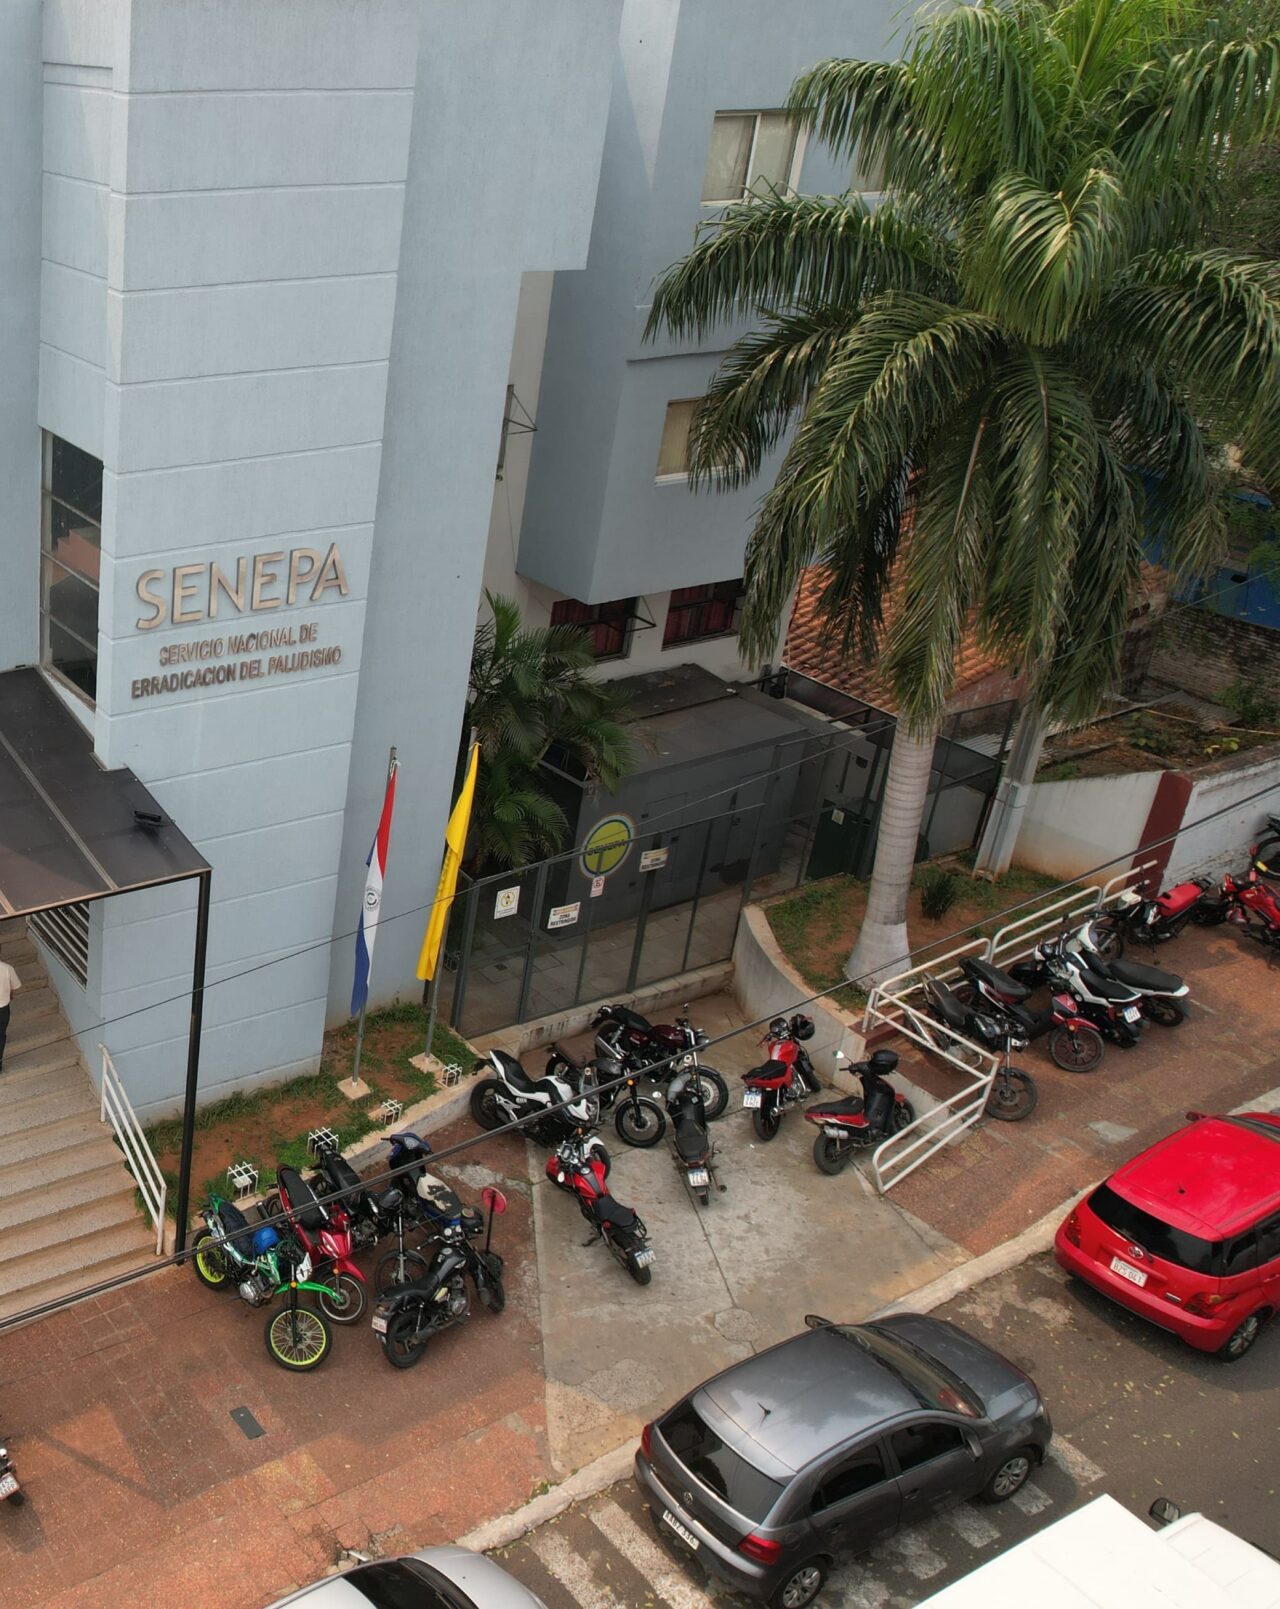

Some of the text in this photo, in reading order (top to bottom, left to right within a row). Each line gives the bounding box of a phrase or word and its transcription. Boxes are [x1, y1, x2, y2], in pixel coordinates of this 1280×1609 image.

[136, 542, 349, 629] SENEPA
[159, 622, 319, 666] SERVICIO NACIONAL DE
[131, 645, 342, 700] ERRADICACION DEL PALUDISMO
